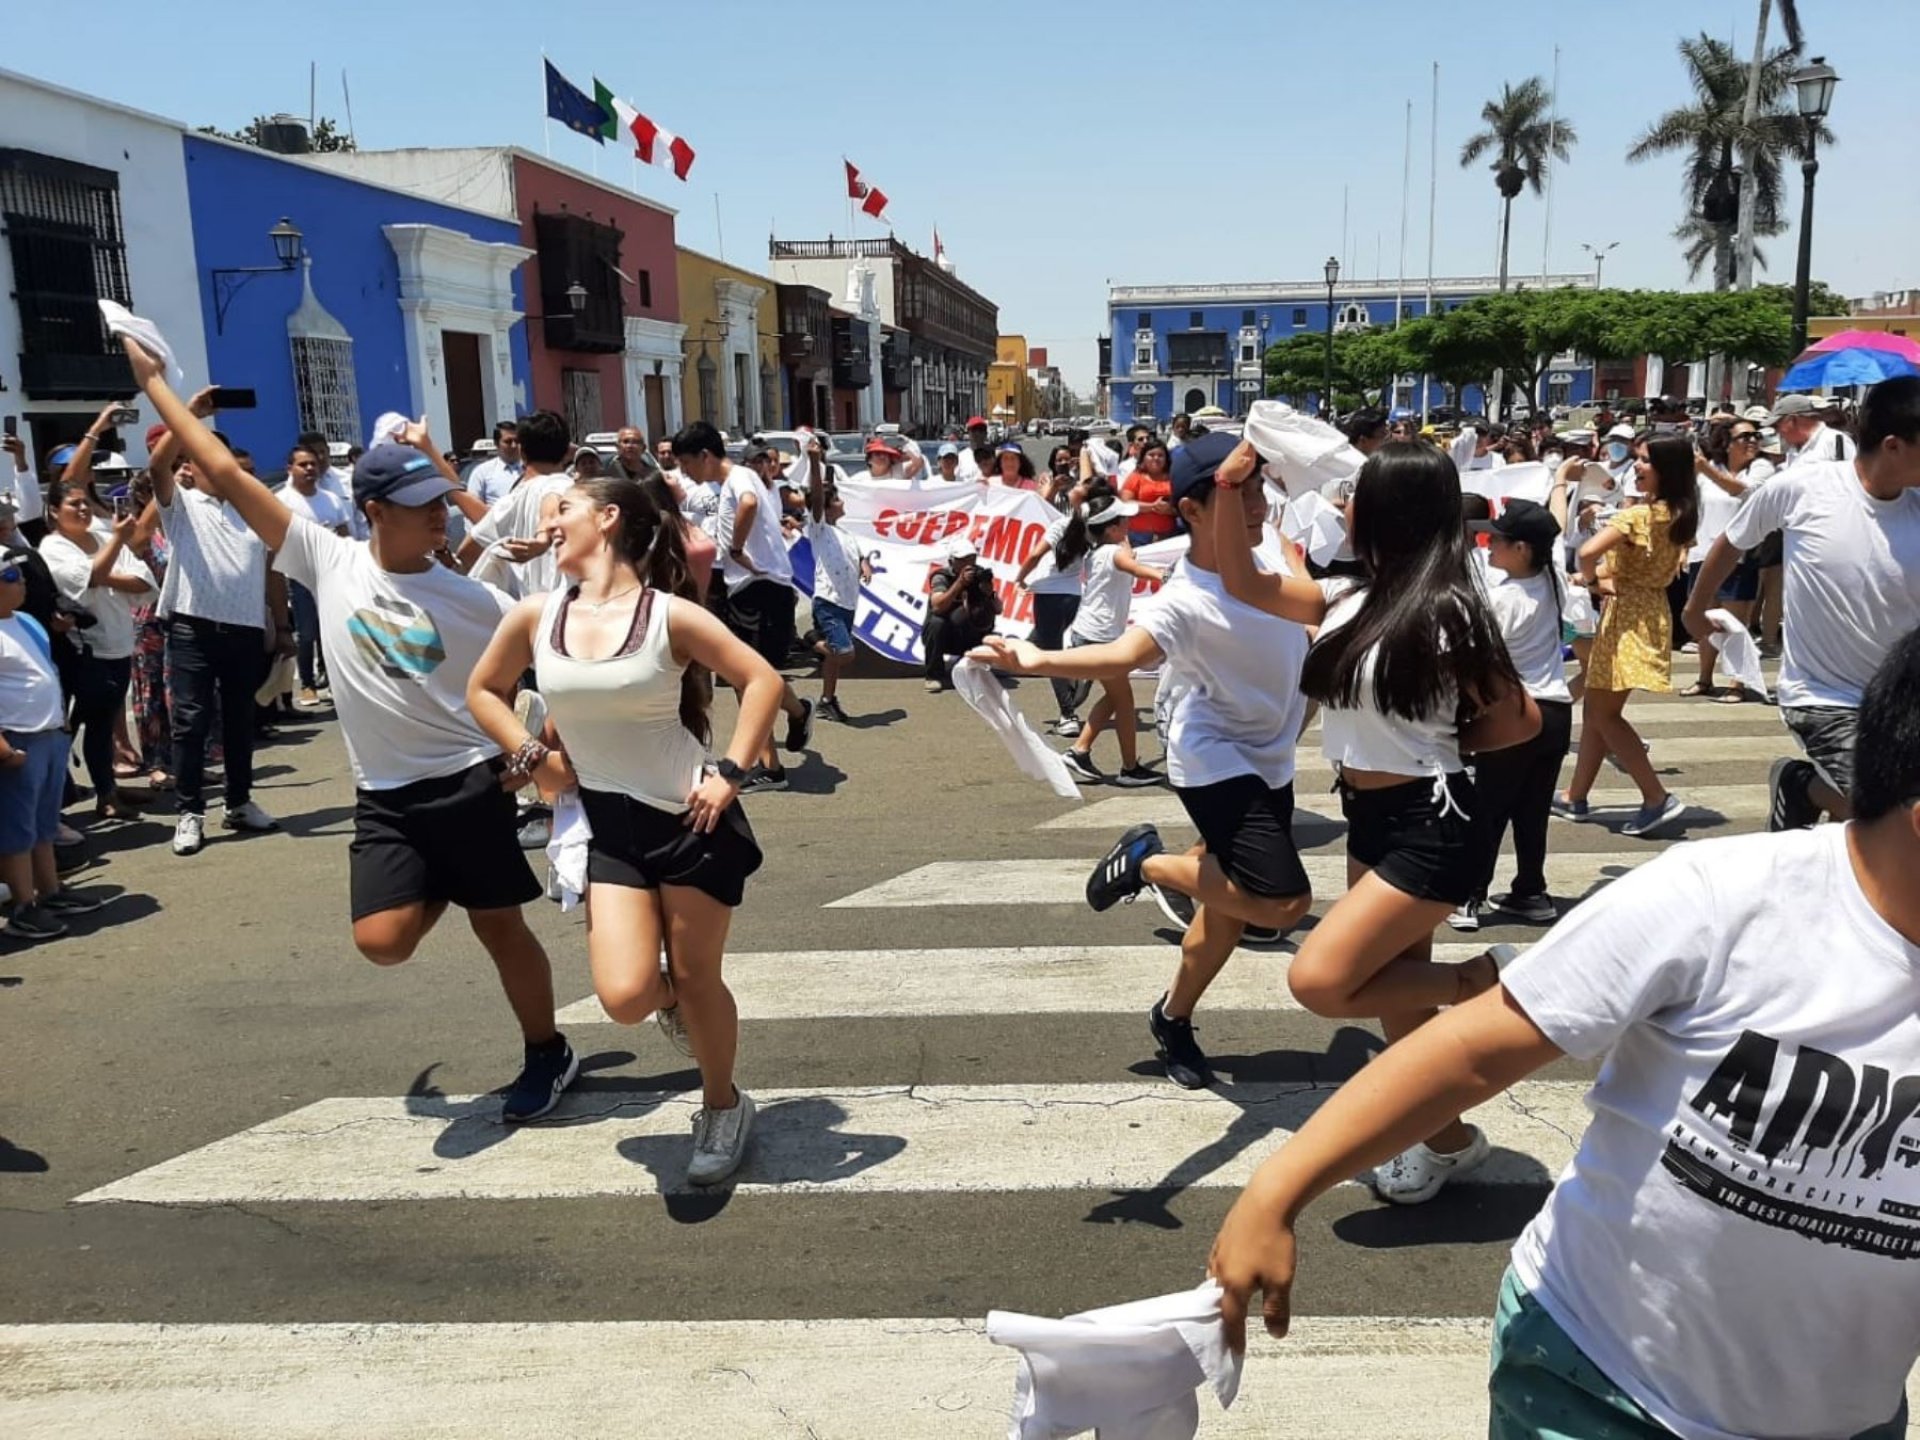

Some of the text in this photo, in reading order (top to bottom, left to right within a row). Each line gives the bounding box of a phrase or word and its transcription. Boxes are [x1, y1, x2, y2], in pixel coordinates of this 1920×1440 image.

[1730, 1160, 1795, 1195] YORK
[1805, 1186, 1865, 1210] CITY
[1718, 1187, 1746, 1208] THE
[1748, 1201, 1786, 1222] BEST
[1788, 1214, 1853, 1238] QUALITY
[1854, 1229, 1908, 1251] STREET
